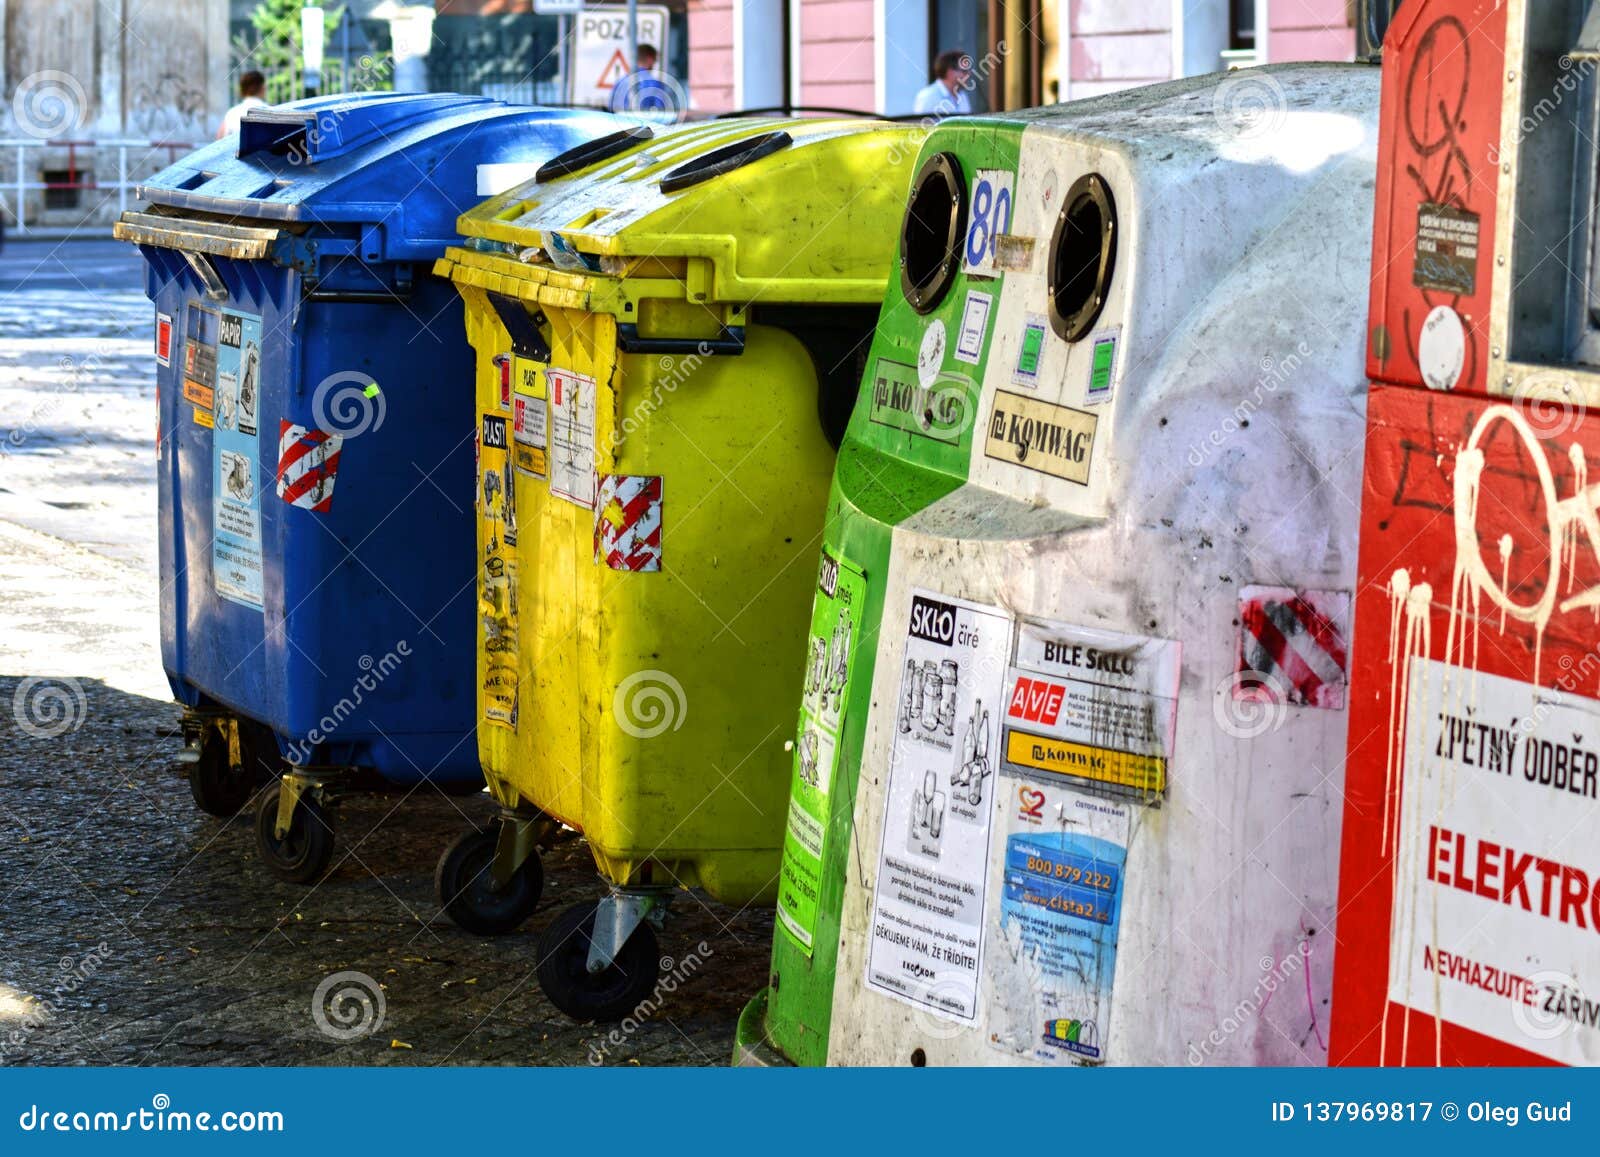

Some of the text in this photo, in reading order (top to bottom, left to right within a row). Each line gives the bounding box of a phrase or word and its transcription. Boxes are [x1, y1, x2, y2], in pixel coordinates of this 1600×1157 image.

[967, 180, 1011, 267] 80
[523, 368, 536, 388] PLAST
[484, 420, 506, 449] PLASTY
[911, 603, 979, 648] SKLO čiré
[1012, 686, 1062, 717] AVE
[1435, 705, 1598, 800] ZPĚTNÝ ODBĚR
[1027, 856, 1111, 890] 800 879 222
[875, 923, 976, 971] DĚKUJEME VÁM, ŽE TŘÍDÍTE!
[1424, 944, 1539, 1008] NEVHAZUJTE:
